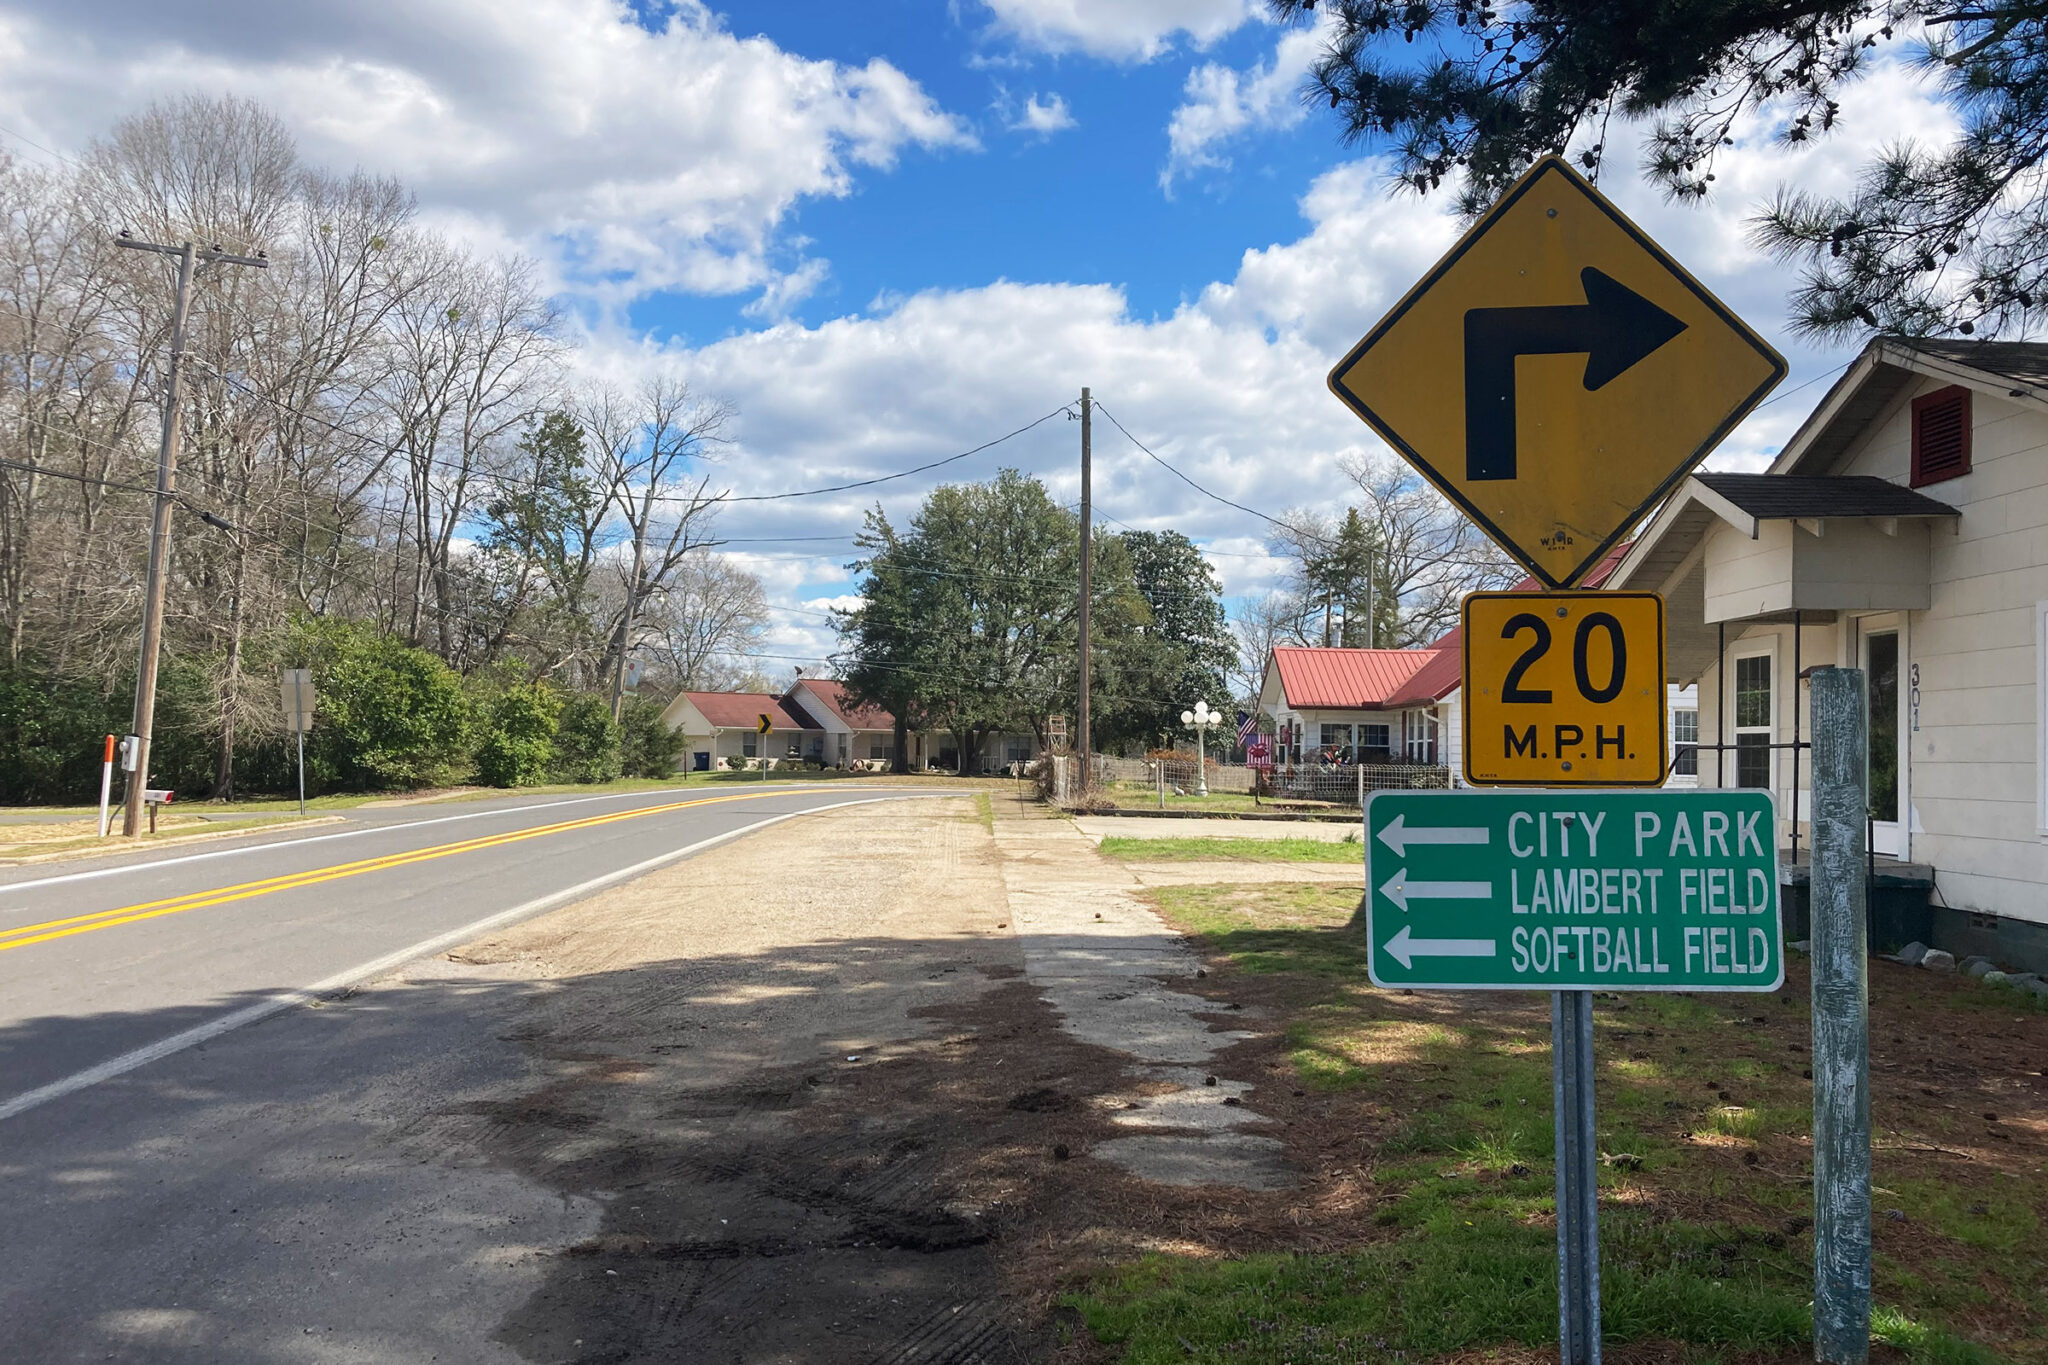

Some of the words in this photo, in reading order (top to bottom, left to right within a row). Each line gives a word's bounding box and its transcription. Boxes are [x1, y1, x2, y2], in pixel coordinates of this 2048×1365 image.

[1501, 612, 1627, 704] 20
[1912, 663, 1920, 731] 301
[1504, 725, 1635, 759] M.P.H.
[1508, 811, 1606, 857] CITY
[1635, 811, 1764, 857] PARK
[1511, 868, 1663, 914] LAMBERT
[1680, 868, 1768, 914] FIELD
[1511, 926, 1669, 973] SOFTBALL
[1684, 926, 1768, 973] FIELD
